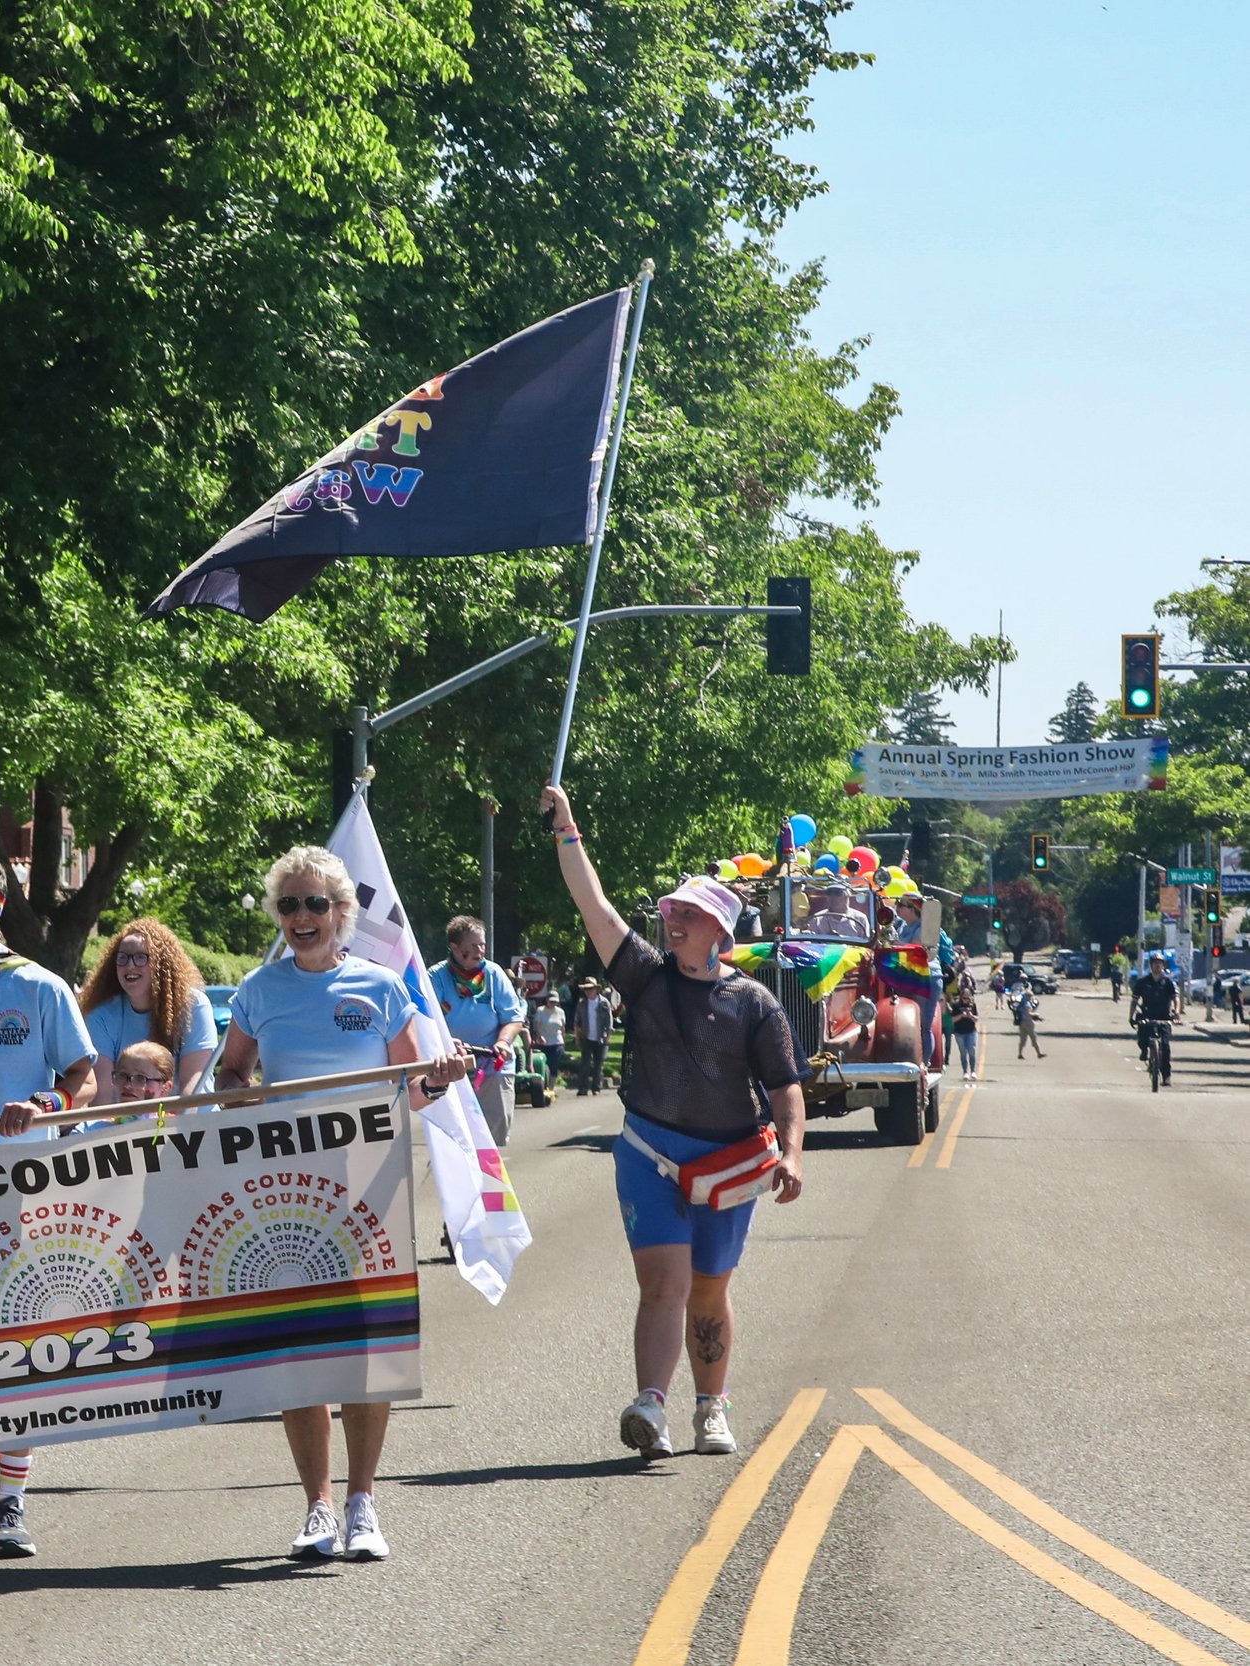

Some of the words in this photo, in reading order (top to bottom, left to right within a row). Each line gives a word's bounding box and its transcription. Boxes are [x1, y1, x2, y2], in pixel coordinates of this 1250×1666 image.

[878, 767, 916, 777] Saturday
[1000, 770, 1025, 778] Smith
[1028, 769, 1061, 777] Theatre
[879, 748, 941, 764] Annual
[947, 750, 1004, 768] Spring
[1010, 748, 1079, 765] Fashion
[1085, 746, 1135, 761] Show
[1170, 871, 1200, 881] Walnut
[1203, 871, 1212, 881] St
[218, 1103, 396, 1166] PRIDE
[19, 1202, 122, 1228] COUNTY
[127, 1229, 173, 1298] PRIDE
[29, 1223, 111, 1244] COUNTY
[116, 1244, 153, 1301] PRIDE
[179, 1192, 235, 1298] KITTITAS
[243, 1172, 348, 1199] COUNTY
[353, 1200, 396, 1270] PRIDE
[198, 1209, 245, 1296] KITTITAS
[252, 1192, 337, 1214] COUNTY
[341, 1215, 377, 1273] PRIDE
[213, 1221, 253, 1295] KITTITAS
[258, 1208, 329, 1227] COUNTY
[333, 1227, 362, 1275] PRIDE
[227, 1233, 260, 1293] KITTITAS
[264, 1222, 322, 1238] COUNTY
[324, 1238, 348, 1278] PRIDE
[240, 1242, 266, 1291] KITTITAS
[269, 1234, 316, 1247] COUNTY
[317, 1247, 337, 1279] PRIDE
[277, 1251, 306, 1260] COUNTY
[1, 1264, 35, 1324] KITTITAS
[40, 1253, 96, 1268] COUNTY
[98, 1268, 124, 1306] PRIDE
[13, 1273, 40, 1323] KITTITAS
[43, 1265, 89, 1278] COUNTY
[91, 1277, 112, 1307] PRIDE
[34, 1239, 103, 1257] COUNTY
[107, 1256, 139, 1304] PRIDE
[50, 1283, 79, 1291] COUNTY
[249, 1250, 270, 1289] KITTITAS
[273, 1243, 310, 1254] COUNTY
[22, 1281, 44, 1321] KITTITAS
[47, 1274, 83, 1285] COUNTY
